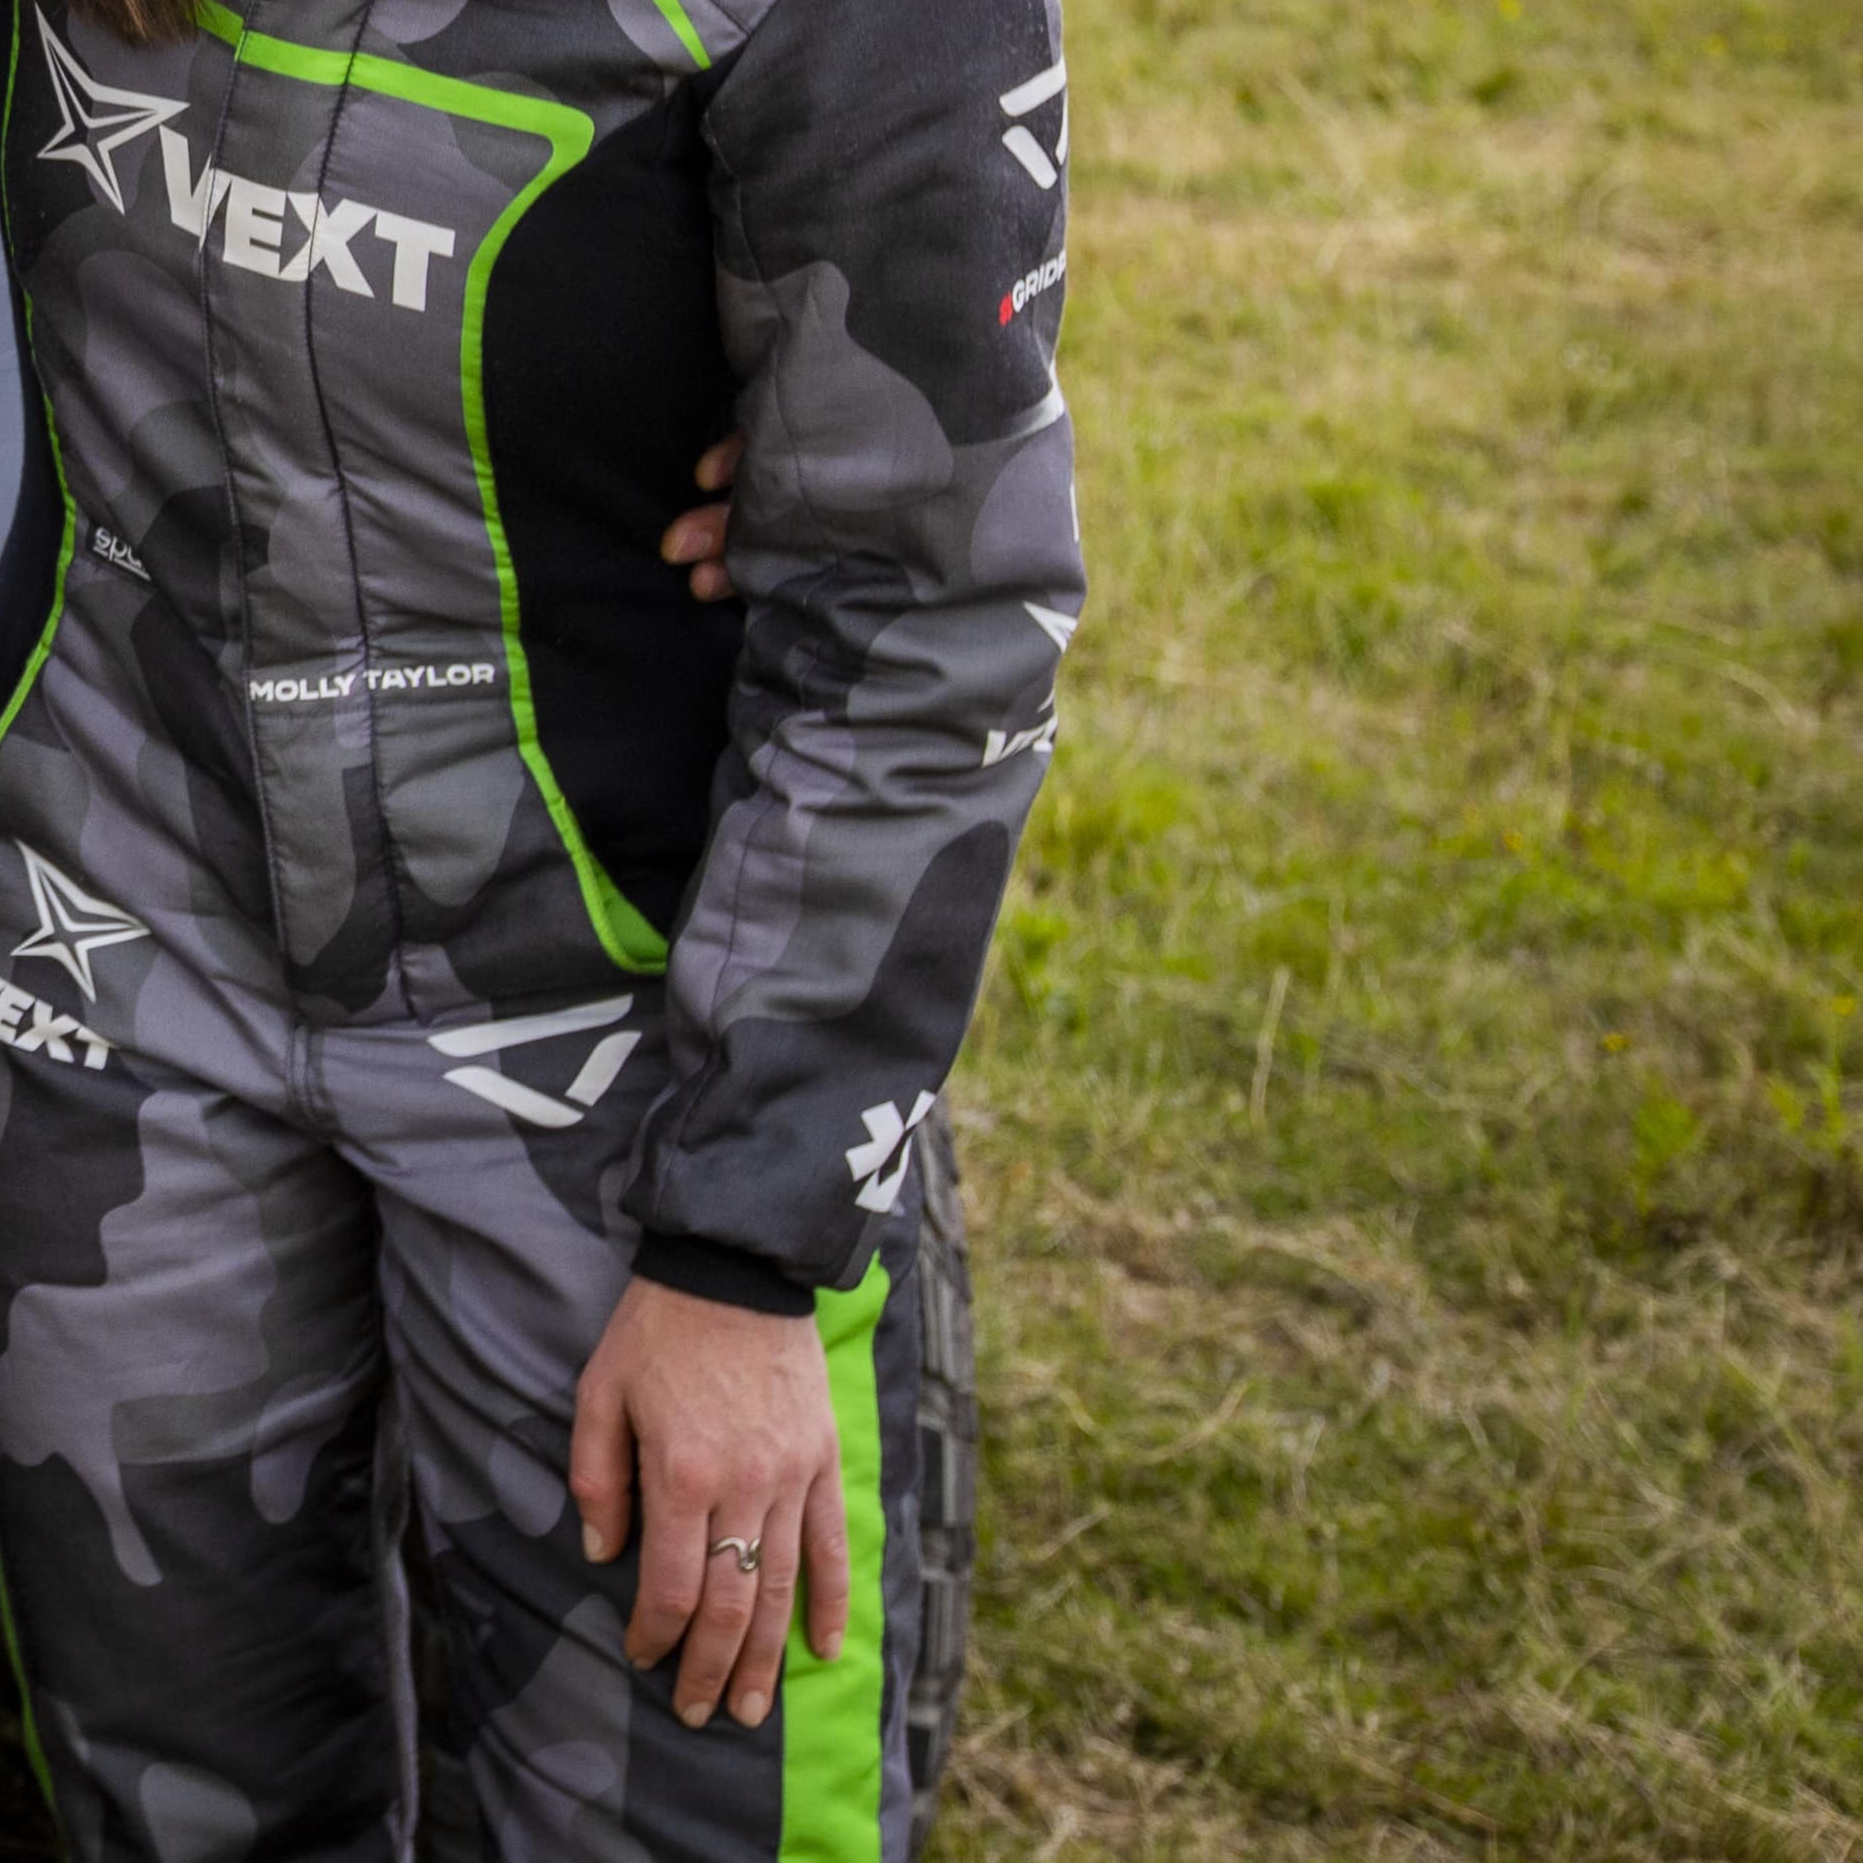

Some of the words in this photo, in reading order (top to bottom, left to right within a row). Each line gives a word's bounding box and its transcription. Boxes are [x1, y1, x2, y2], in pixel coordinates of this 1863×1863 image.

[158, 124, 455, 313] VEXT
[248, 673, 356, 703] MOLLY
[361, 663, 496, 691] TAYLOR
